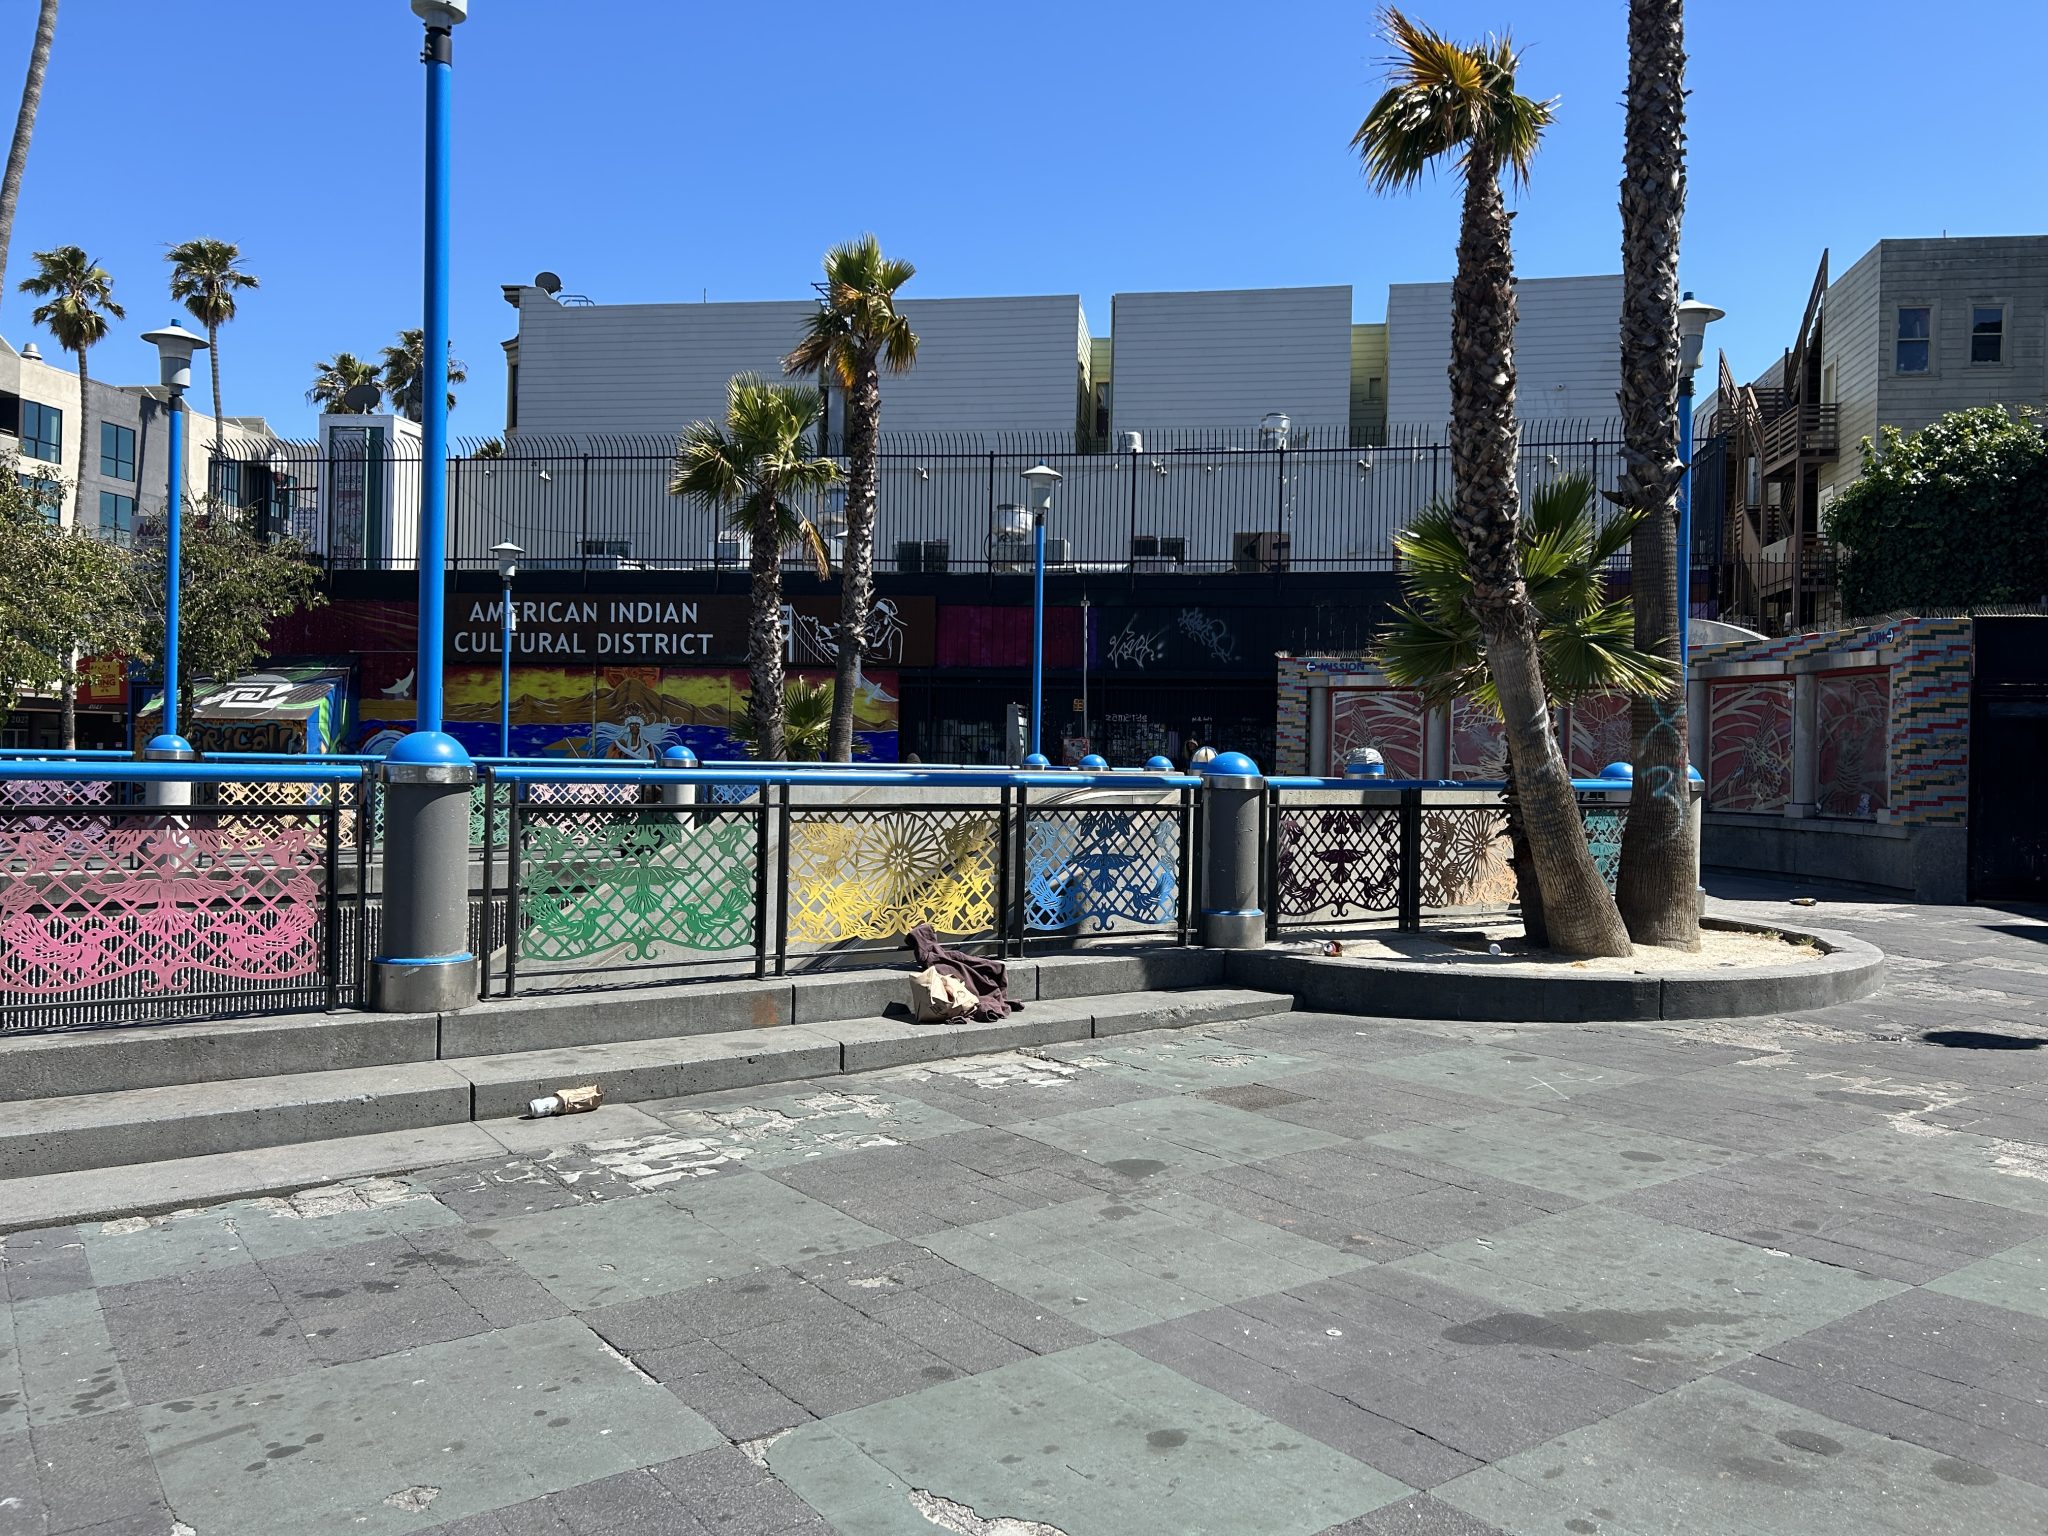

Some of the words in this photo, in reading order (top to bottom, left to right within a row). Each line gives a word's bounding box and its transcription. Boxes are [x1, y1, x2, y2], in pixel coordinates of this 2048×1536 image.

[611, 602, 698, 623] INDIAN
[454, 632, 586, 653] CULTURAL
[598, 633, 714, 655] DISTRICT
[1320, 662, 1365, 672] MISSION
